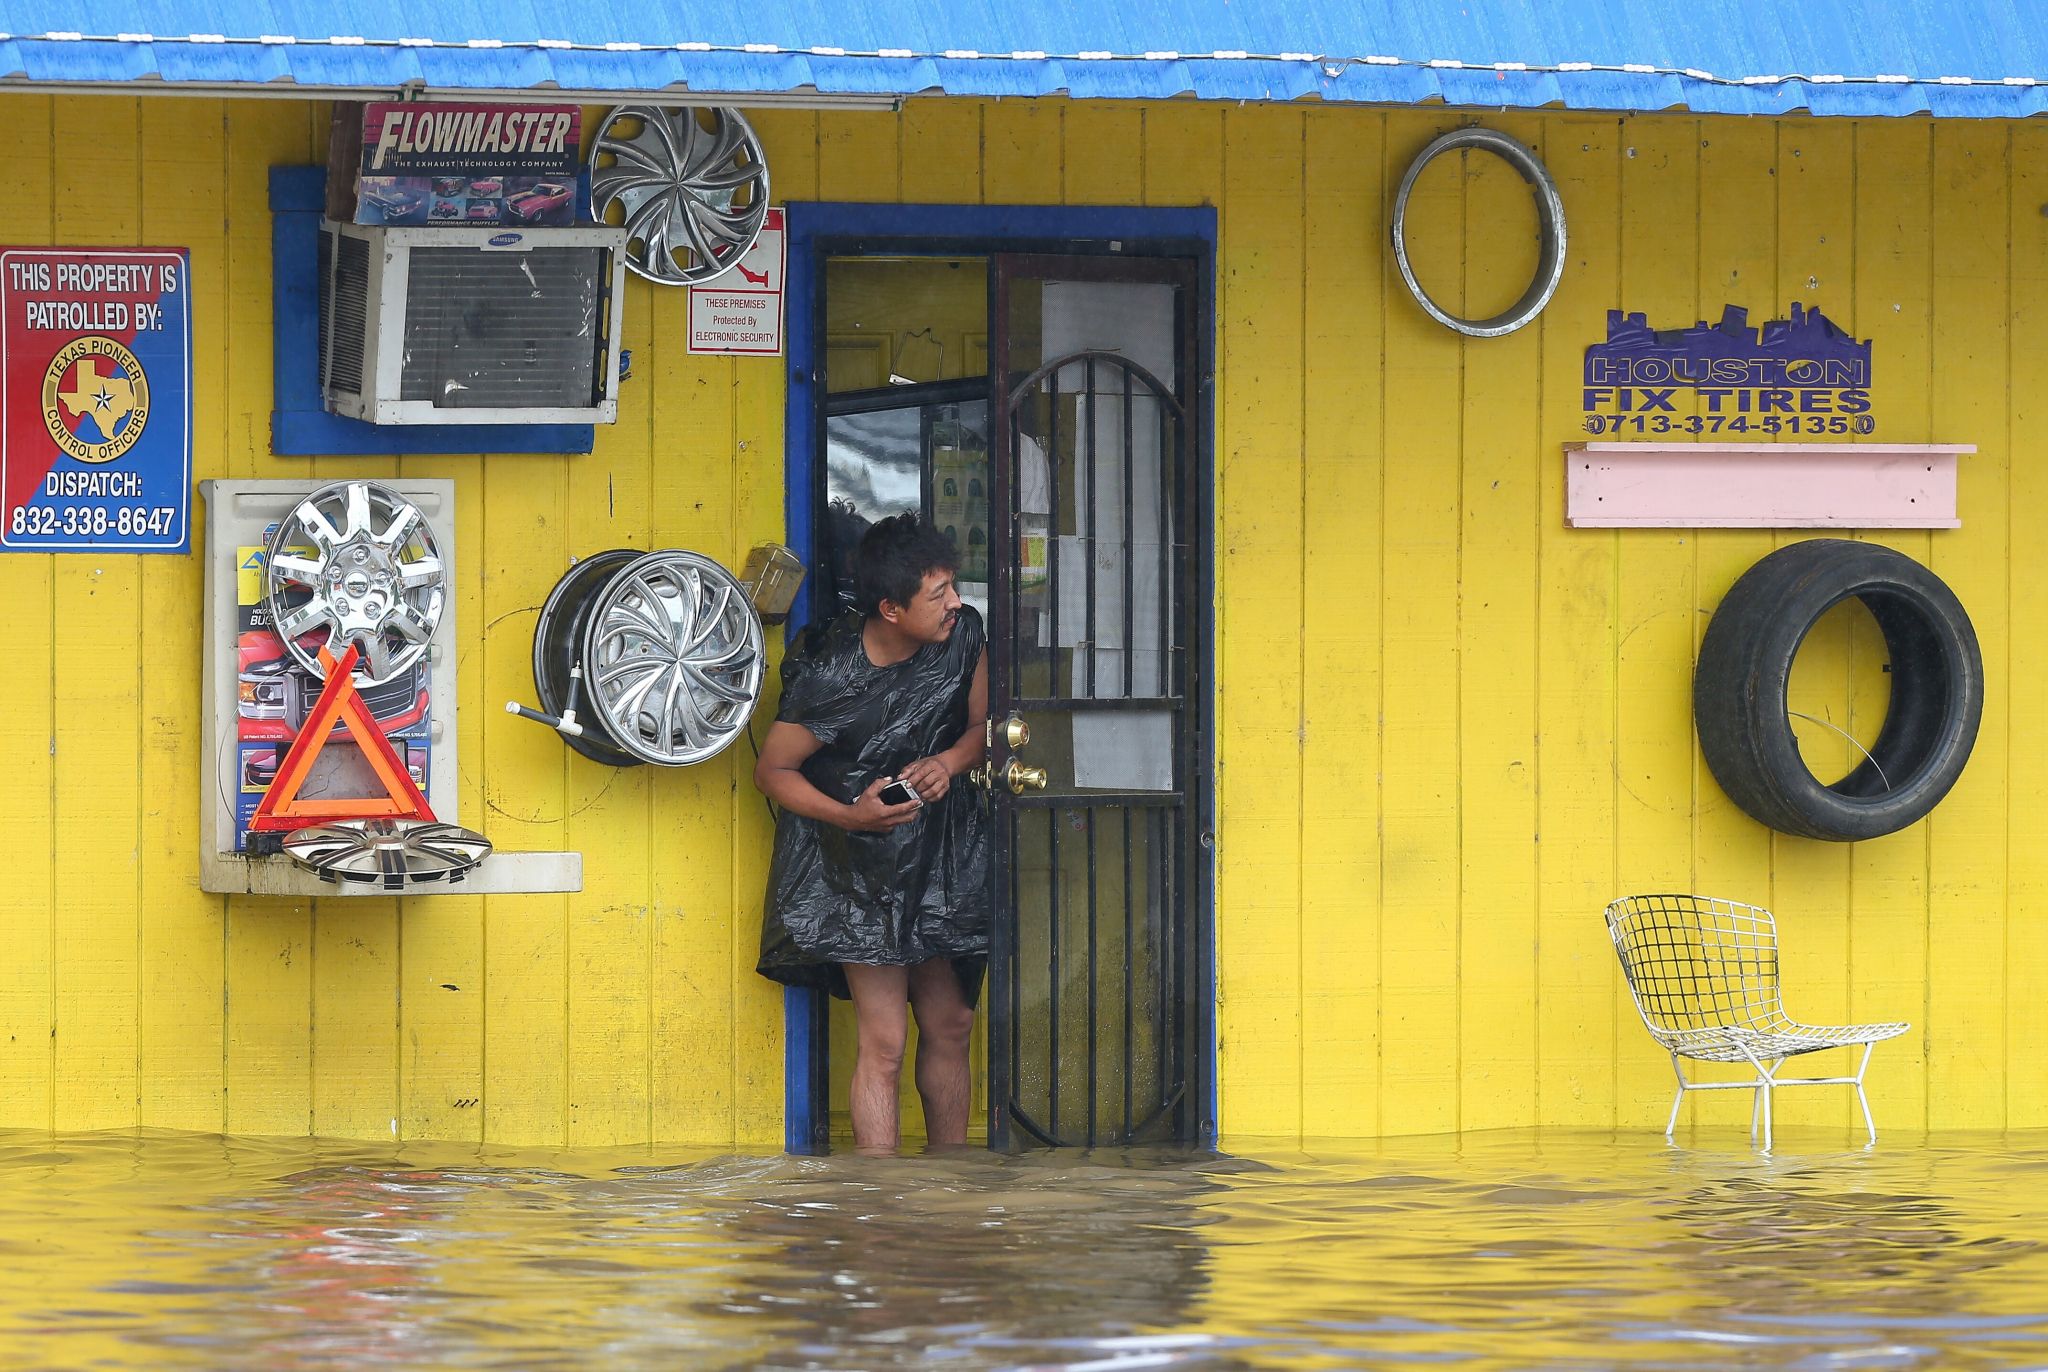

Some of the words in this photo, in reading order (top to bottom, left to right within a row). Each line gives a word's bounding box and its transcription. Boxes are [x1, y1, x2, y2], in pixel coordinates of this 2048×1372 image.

[372, 111, 572, 170] FLOWMASTER
[9, 263, 51, 291] THIS
[56, 264, 153, 292] PROPERTY
[160, 264, 177, 293] IS
[26, 301, 129, 331] PATROLLED
[135, 303, 163, 331] BY:
[705, 298, 728, 308] THESE
[730, 299, 766, 309] PREMISES
[713, 315, 746, 326] Protected
[748, 316, 757, 327] By
[696, 331, 738, 342] ELECTRONIC
[740, 332, 774, 343] SECURITY
[49, 342, 87, 380] TEXAS
[91, 340, 141, 382] PIONEER
[1592, 357, 1864, 385] HOUSTON
[1582, 388, 1677, 412] FIX
[1697, 389, 1871, 413] TIRES
[47, 409, 93, 459] CONTROL
[98, 410, 145, 458] OFFICERS
[1607, 415, 1849, 434] 713-374-5135
[45, 471, 142, 497] DISPATCH:
[12, 506, 175, 535] 832-338-8647
